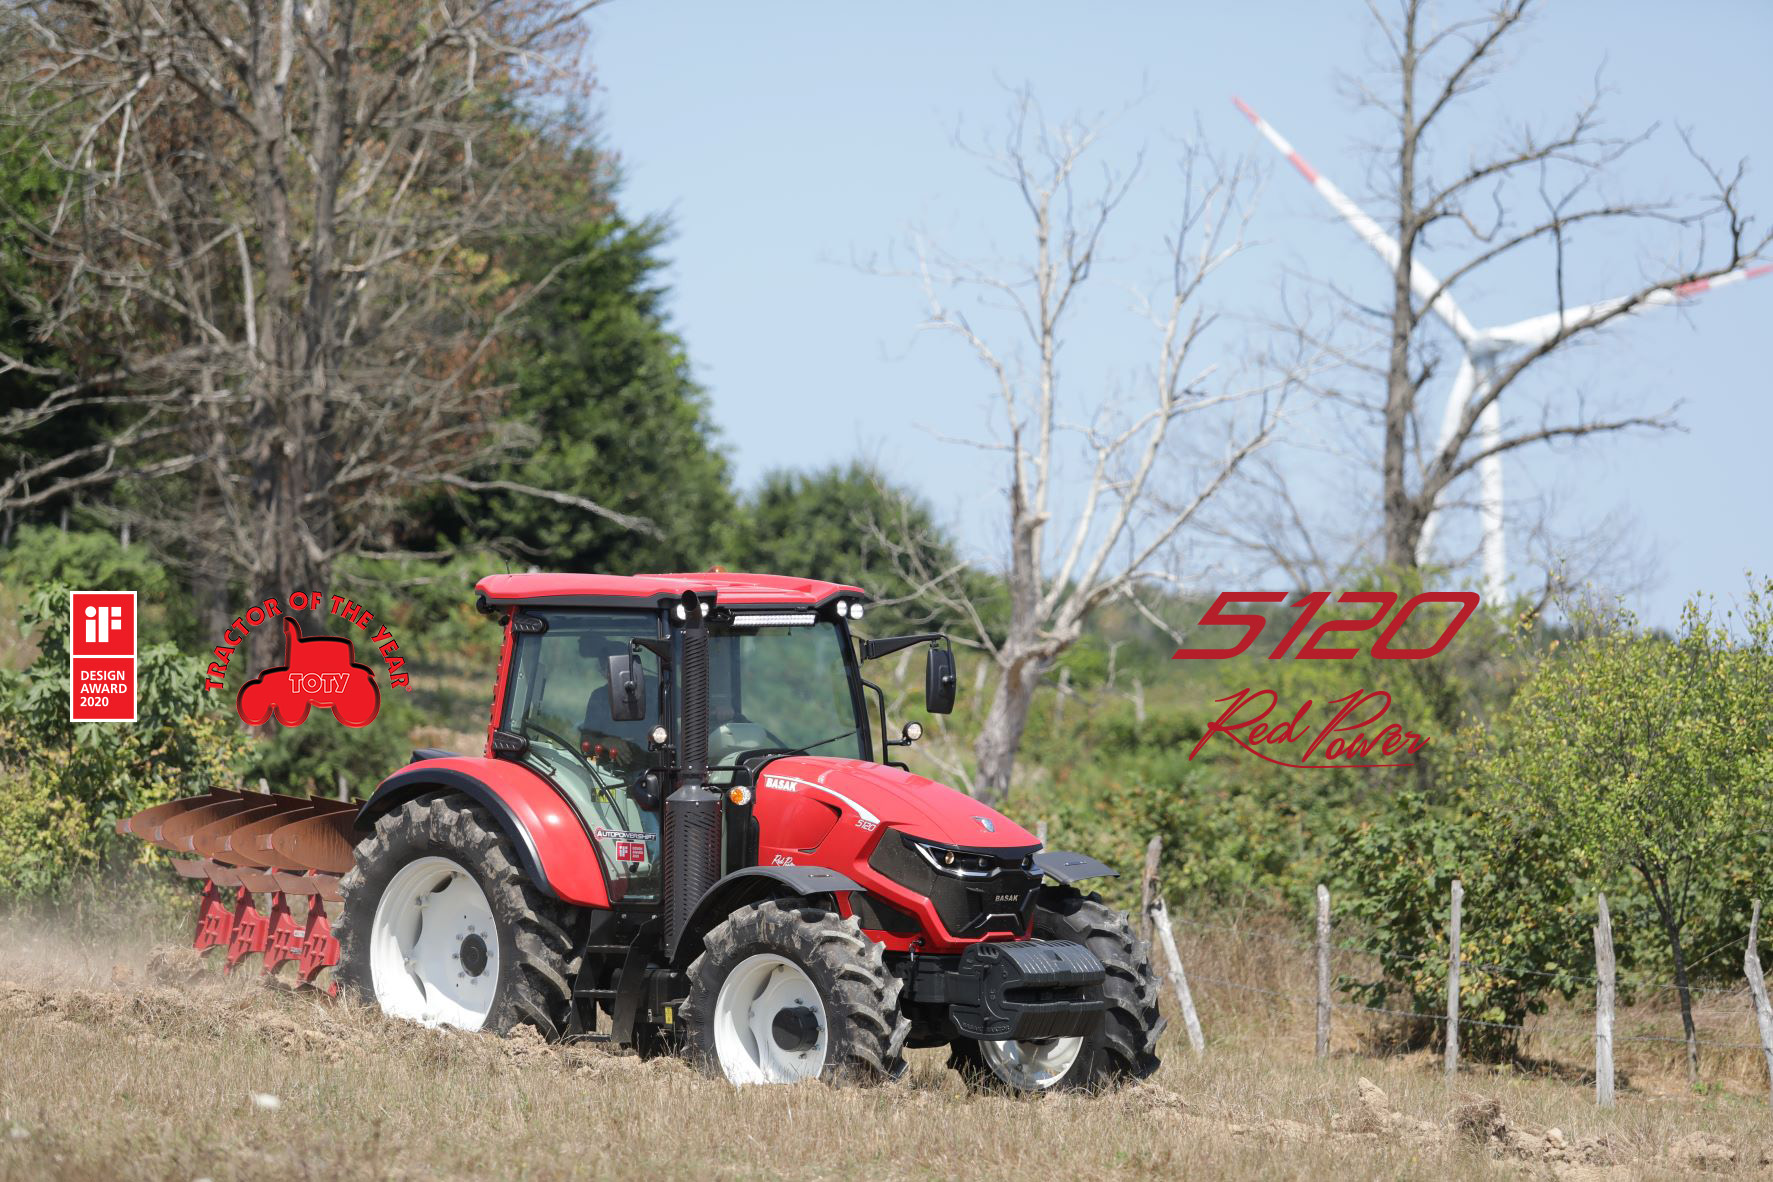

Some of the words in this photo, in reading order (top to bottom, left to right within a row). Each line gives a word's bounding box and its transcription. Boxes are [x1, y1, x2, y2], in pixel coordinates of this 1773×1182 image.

[765, 777, 797, 792] BASAK
[854, 819, 877, 832] 5120
[597, 829, 656, 840] AUTOPOWERSHIFT
[994, 894, 1019, 902] BASAK
